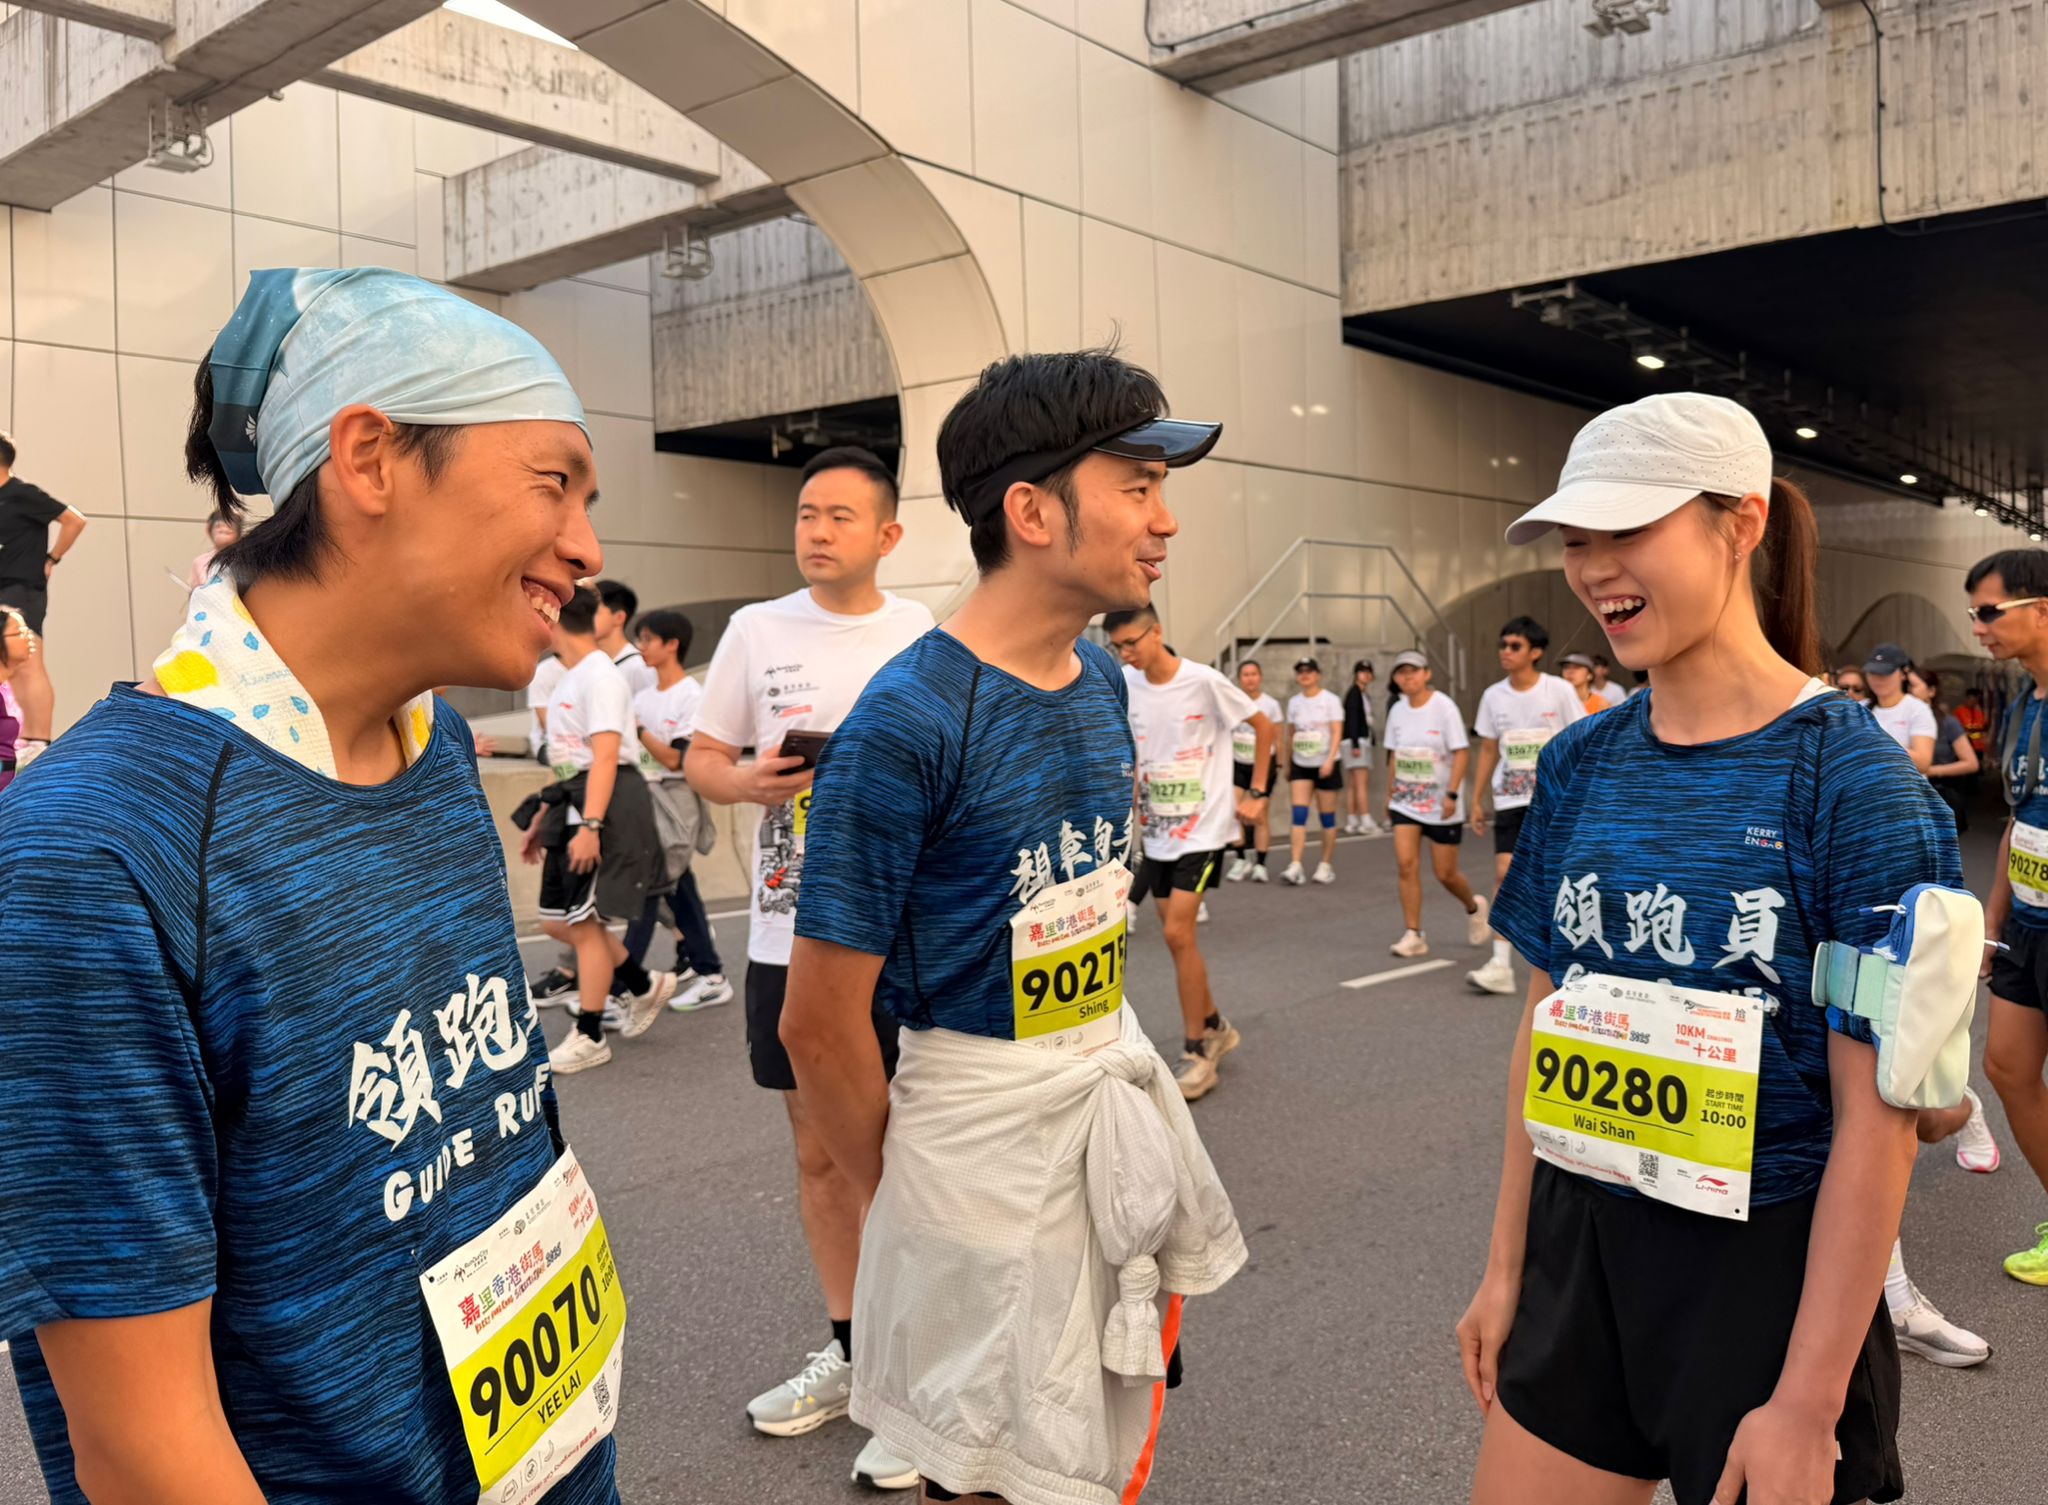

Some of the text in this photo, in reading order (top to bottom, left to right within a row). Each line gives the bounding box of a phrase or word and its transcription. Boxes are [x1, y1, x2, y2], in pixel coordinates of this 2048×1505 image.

[1746, 826, 1778, 839] KERRY
[1553, 872, 1786, 984] 領跑員
[1079, 999, 1109, 1018] Shing
[1549, 999, 1631, 1031] 嘉里香港街馬
[1676, 1023, 1706, 1040] 10KM
[348, 972, 539, 1152] 領跑
[1693, 1042, 1737, 1063] 十公里
[1536, 1047, 1688, 1125] 90280
[1705, 1087, 1745, 1104] 起步時間
[1700, 1108, 1747, 1130] 10:00
[1705, 1098, 1744, 1112] START TIME
[1573, 1112, 1636, 1141] Wai Shan
[457, 1239, 546, 1330] 嘉里香港街馬
[470, 1264, 602, 1440] 90070
[537, 1369, 582, 1424] YEE LAI
